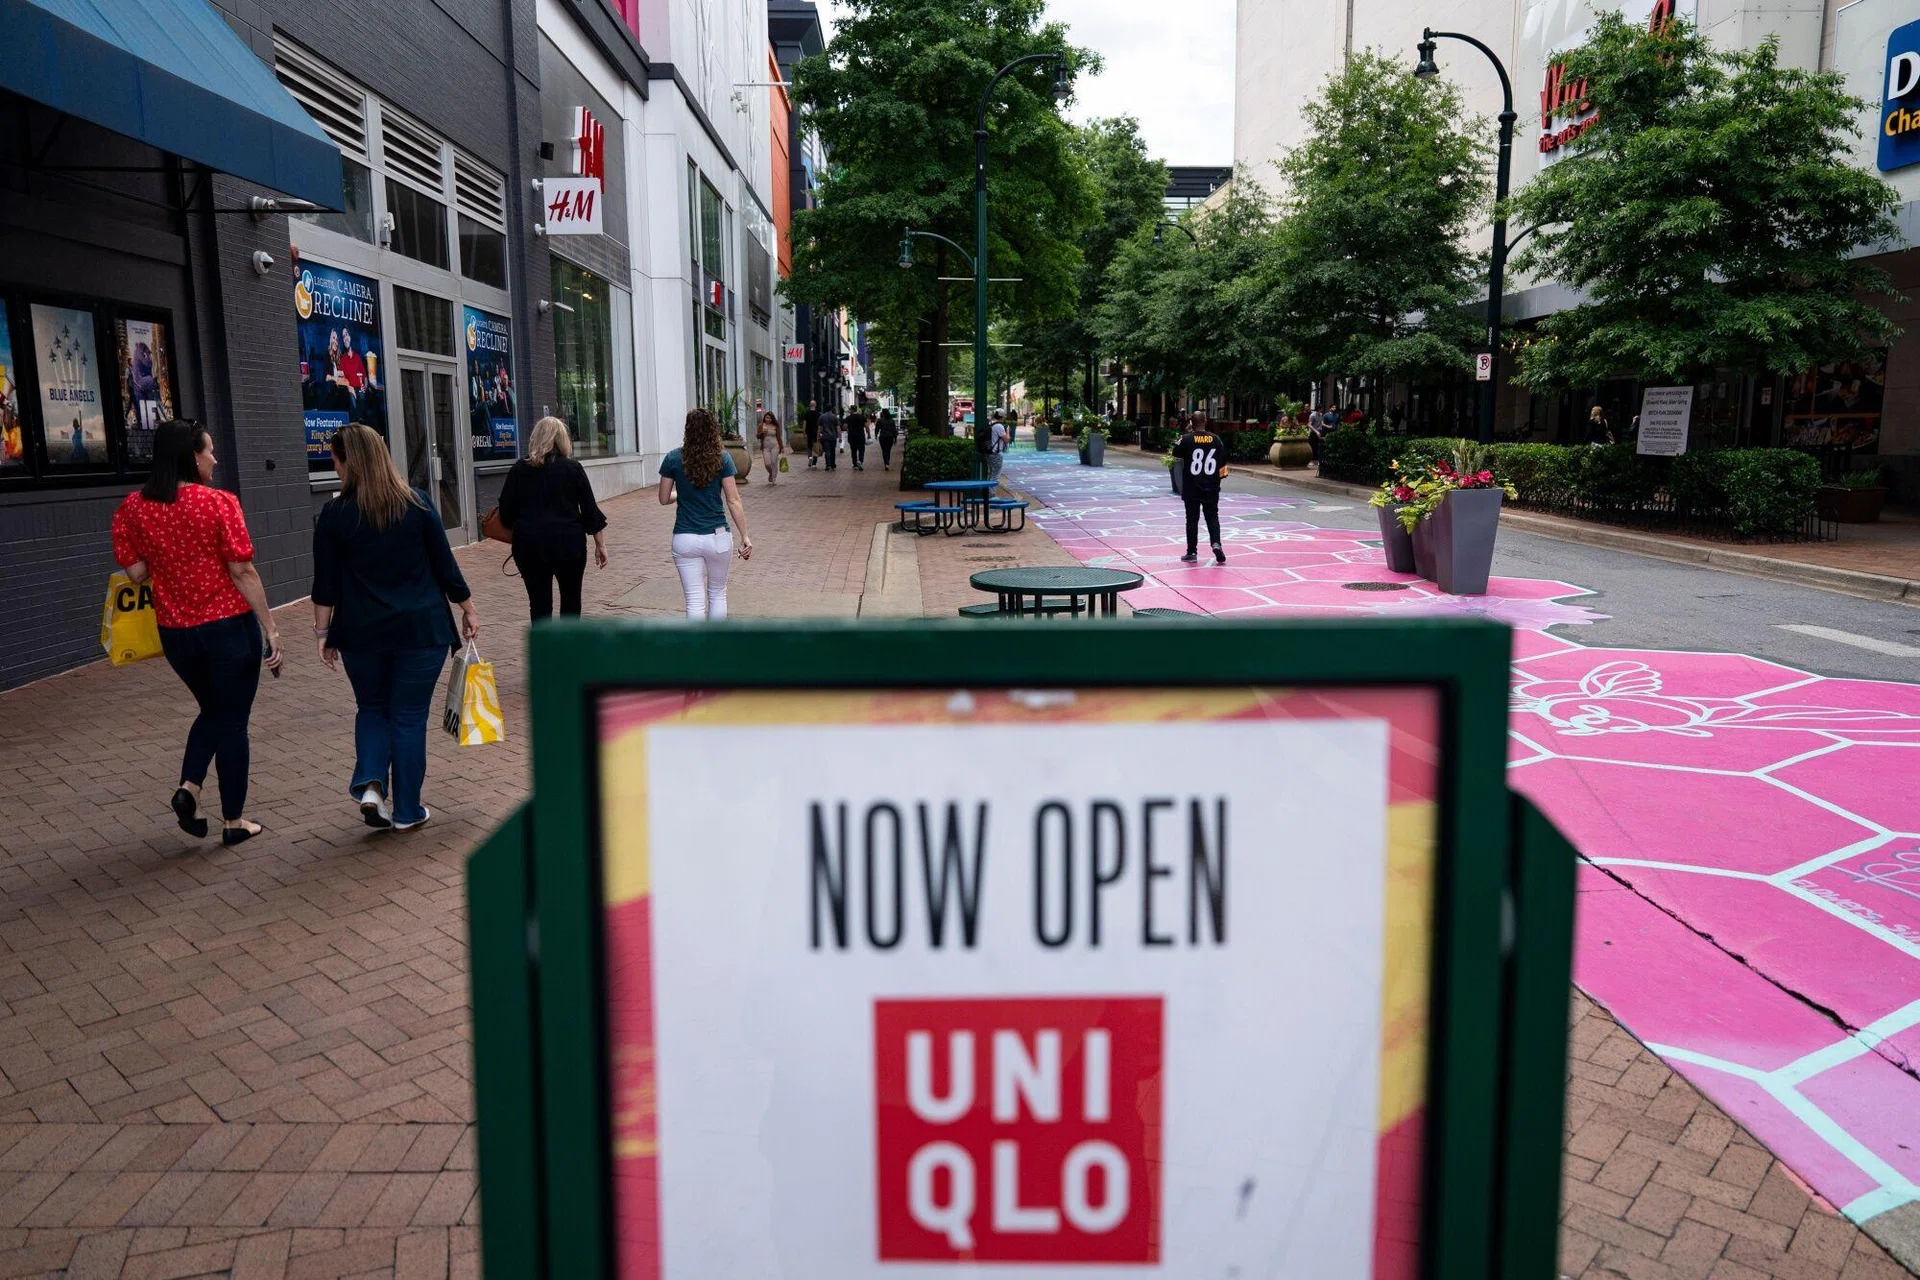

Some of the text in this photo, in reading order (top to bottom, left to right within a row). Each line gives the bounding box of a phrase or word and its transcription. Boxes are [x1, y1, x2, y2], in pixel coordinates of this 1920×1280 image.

[548, 189, 595, 222] H&M
[337, 279, 374, 303] CAMERA,
[313, 291, 373, 325] RECLINE!
[49, 388, 96, 403] BLUE ANGELS
[1193, 435, 1214, 444] WARD
[1190, 448, 1217, 476] 86
[808, 796, 1228, 951] NOW OPEN
[904, 1027, 1112, 1125] UNI
[907, 1139, 1131, 1251] QLO
